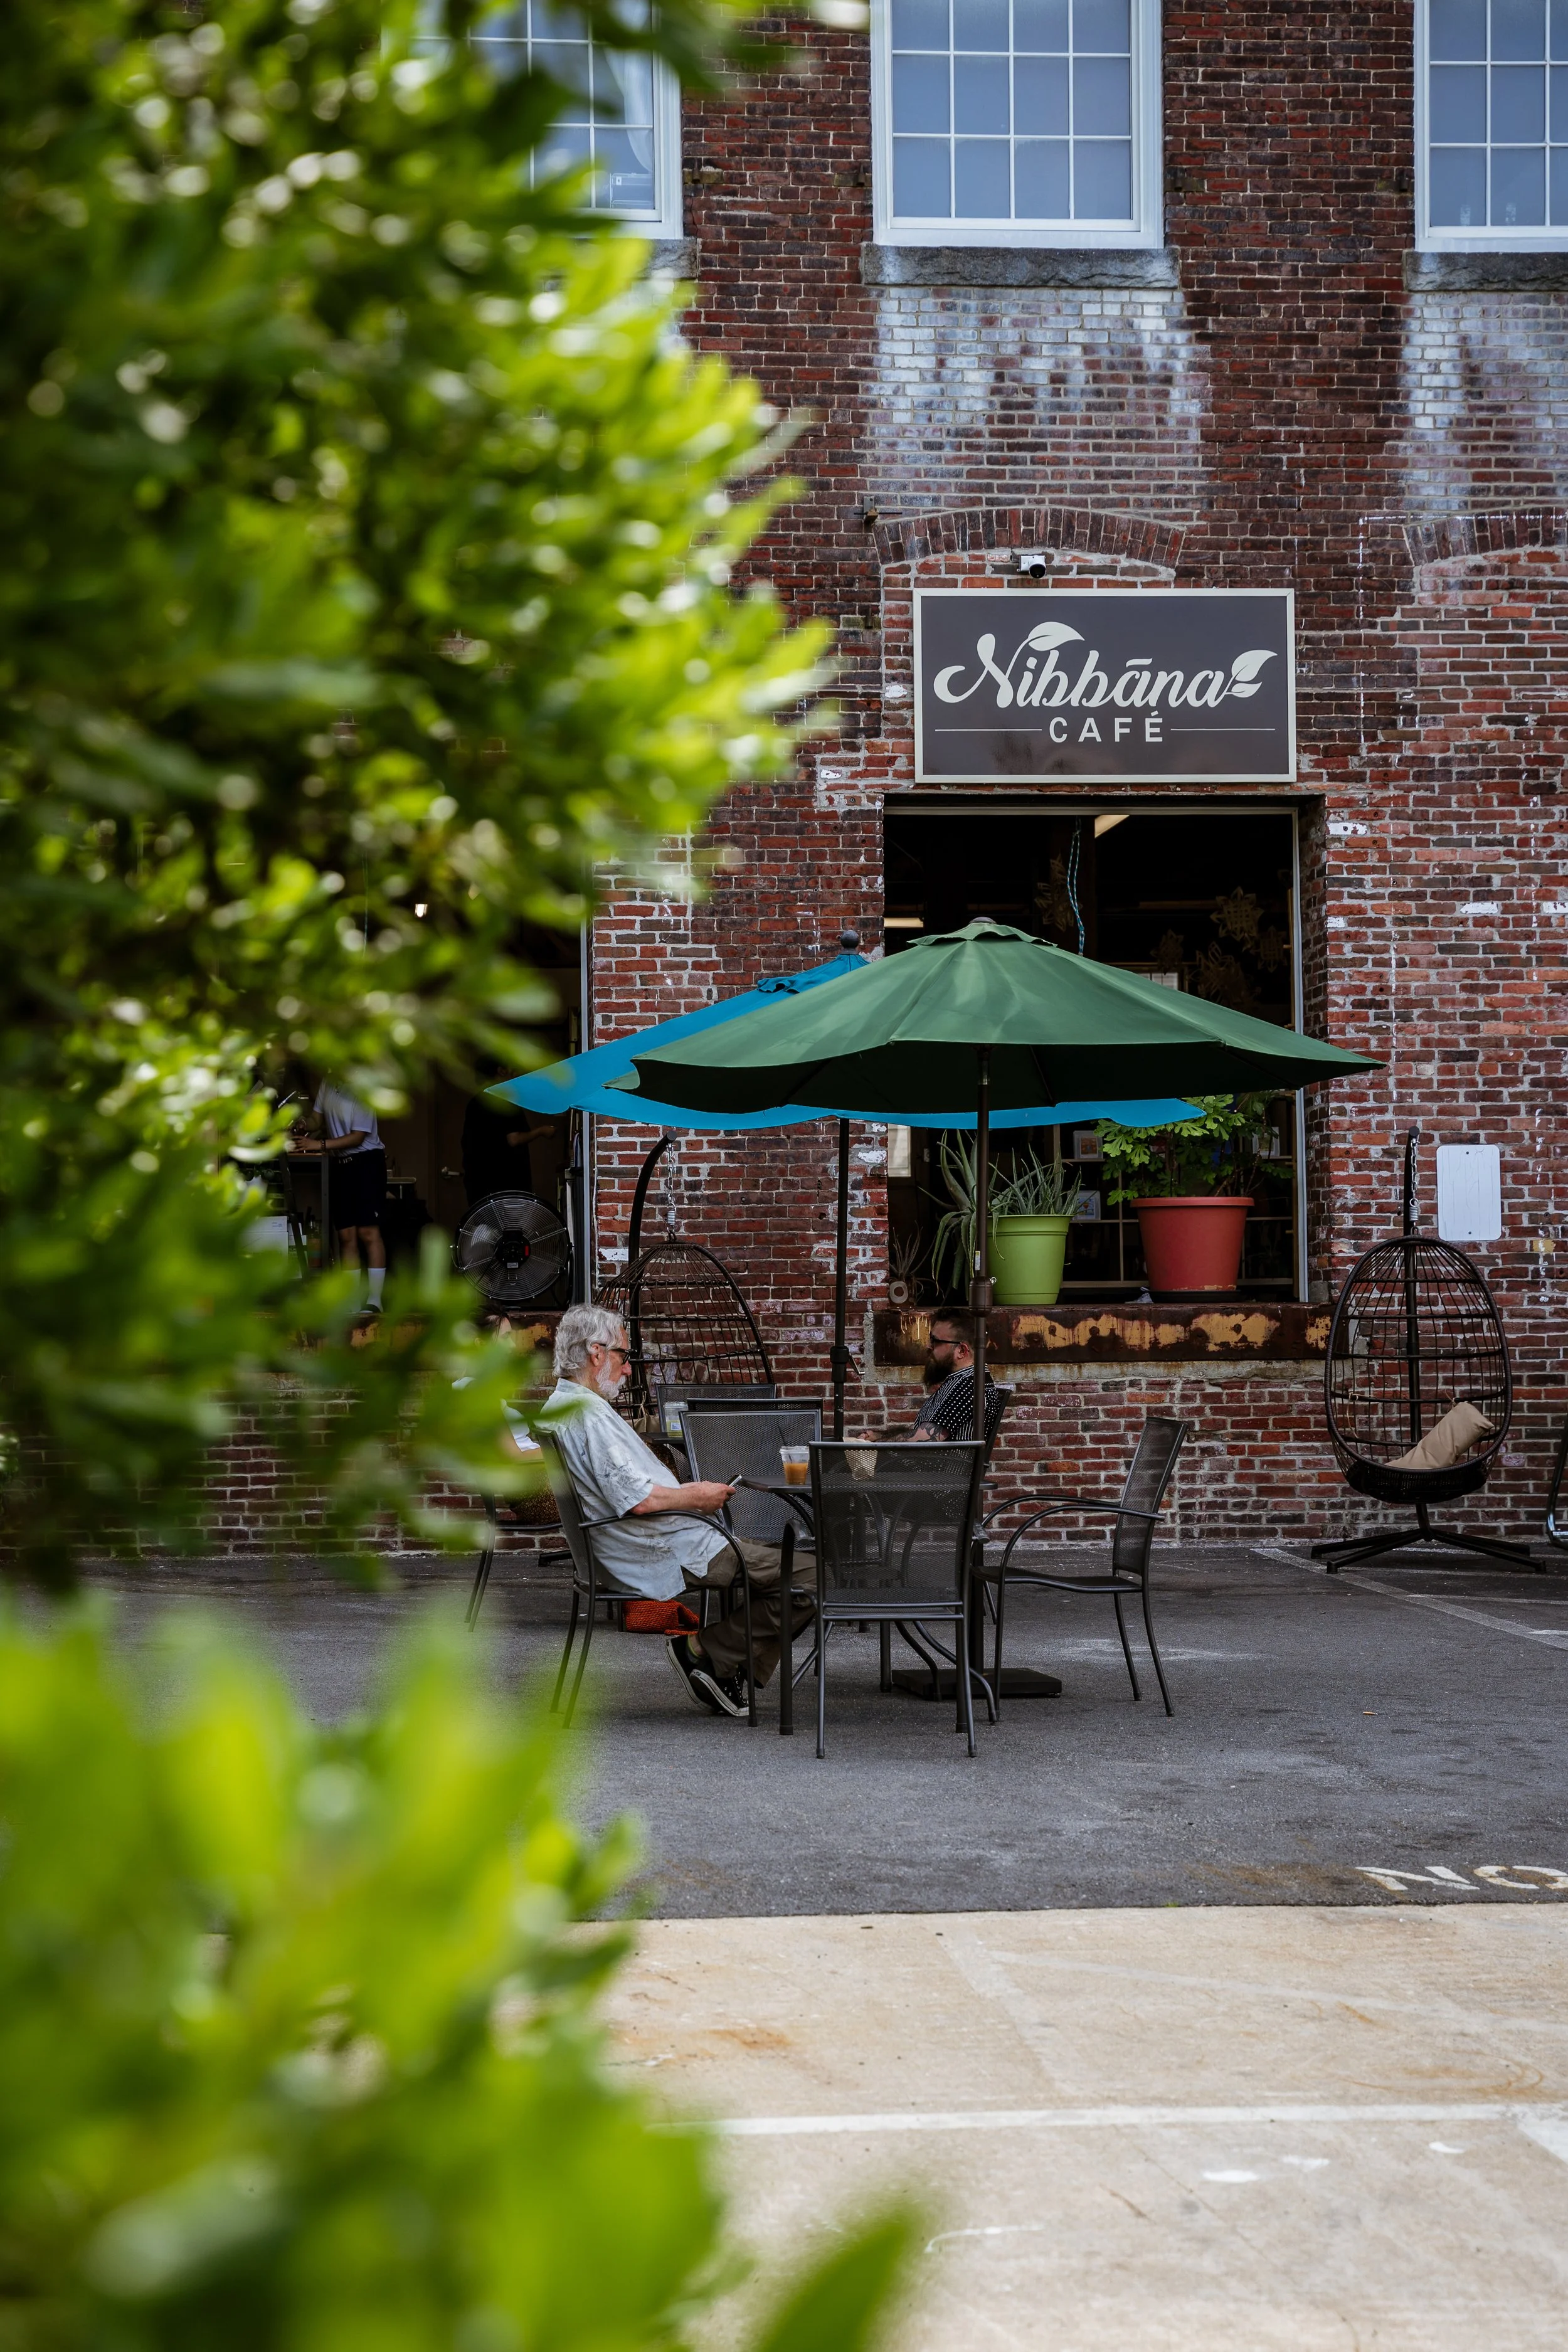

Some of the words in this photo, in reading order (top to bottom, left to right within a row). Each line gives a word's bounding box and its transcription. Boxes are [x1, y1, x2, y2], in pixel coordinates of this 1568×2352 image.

[933, 621, 1234, 708] Nibbāna
[1049, 710, 1163, 743] CAFÉ
[1355, 1865, 1568, 1890] NO
